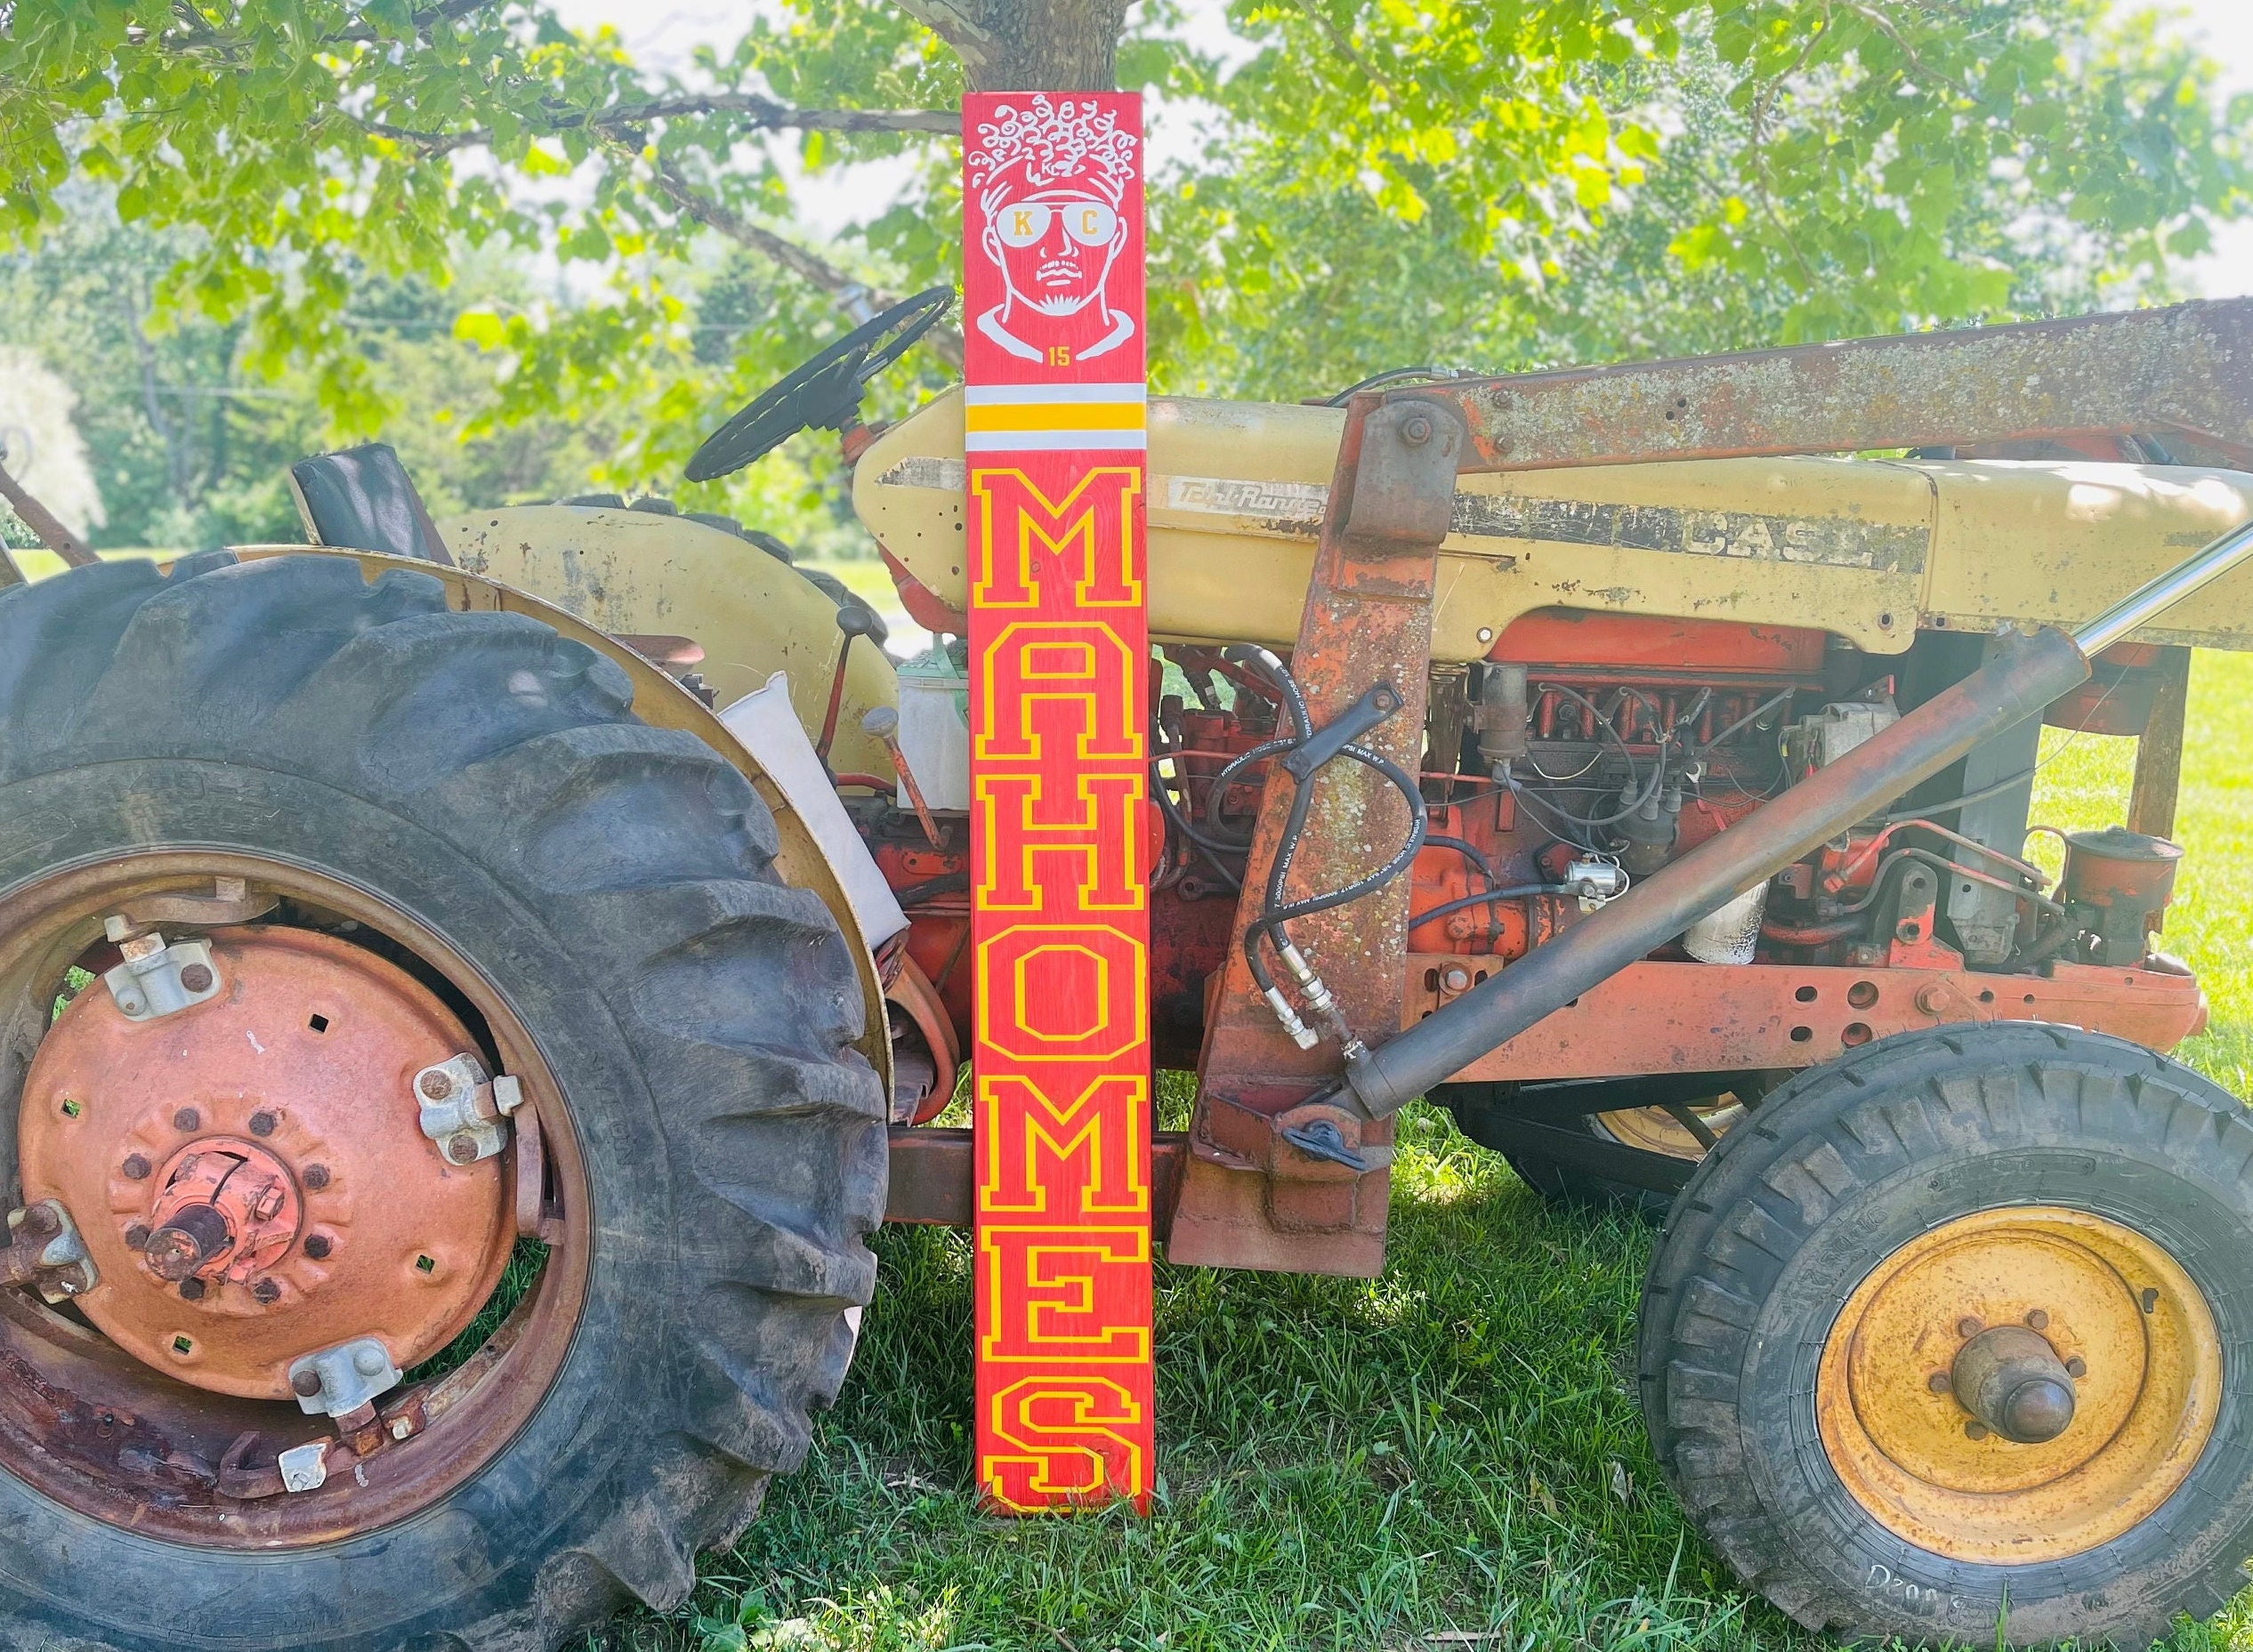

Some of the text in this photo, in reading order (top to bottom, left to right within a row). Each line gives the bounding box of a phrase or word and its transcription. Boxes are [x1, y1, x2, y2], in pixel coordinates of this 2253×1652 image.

[1013, 210, 1098, 236] K C
[1048, 345, 1070, 367] 15
[1288, 679, 1302, 698] HOSE
[1299, 700, 1312, 738] DRAULIC
[1220, 752, 1251, 777] HYDRAULIC
[1357, 748, 1372, 759] MAX
[1282, 851, 1293, 869] MAX
[972, 466, 1150, 1514] MAHOMES
